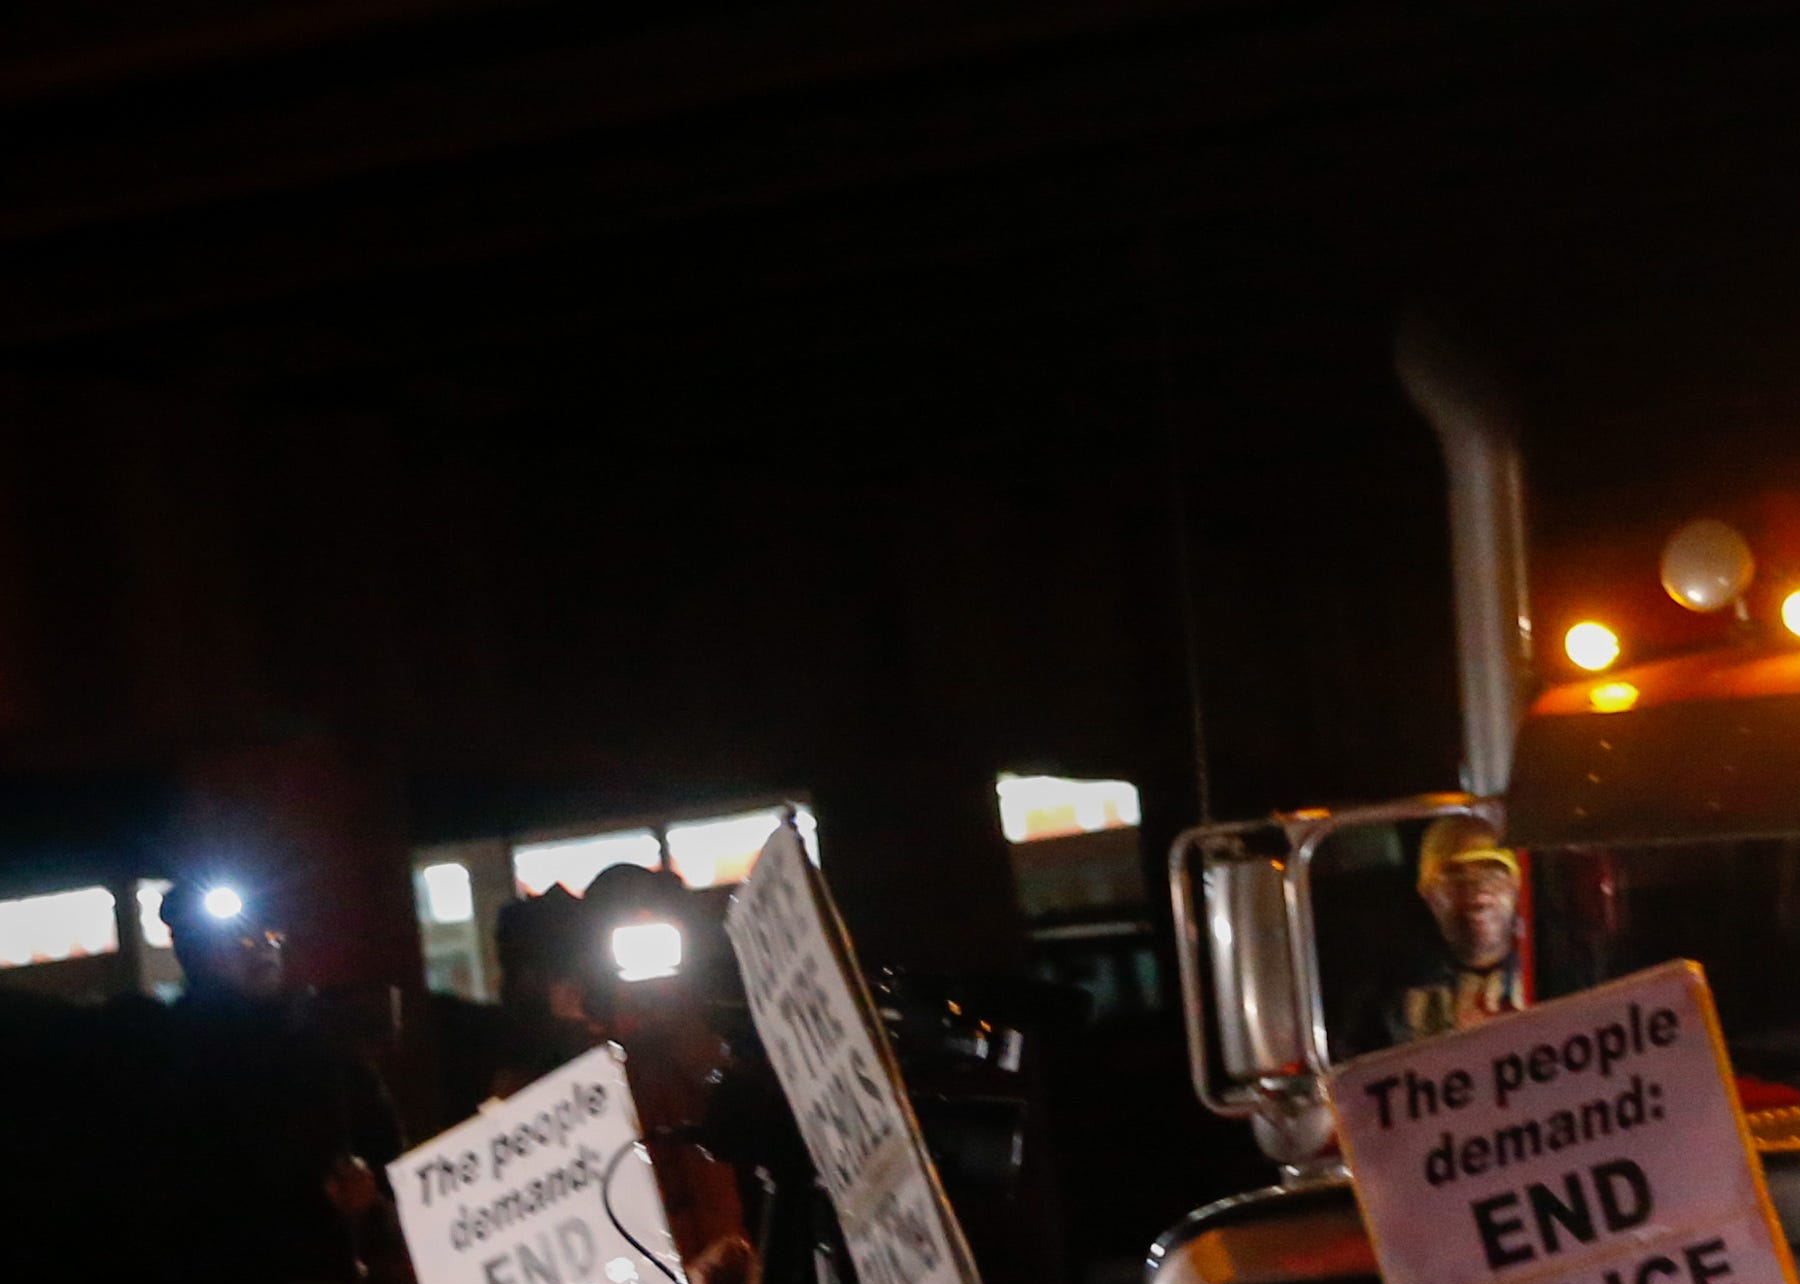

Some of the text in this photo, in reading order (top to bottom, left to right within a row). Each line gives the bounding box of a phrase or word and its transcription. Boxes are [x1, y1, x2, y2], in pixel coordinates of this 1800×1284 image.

[1364, 1003, 1680, 1130] The people
[416, 1082, 608, 1206] The people
[1425, 1078, 1665, 1187] demand:
[1470, 1156, 1654, 1271] END
